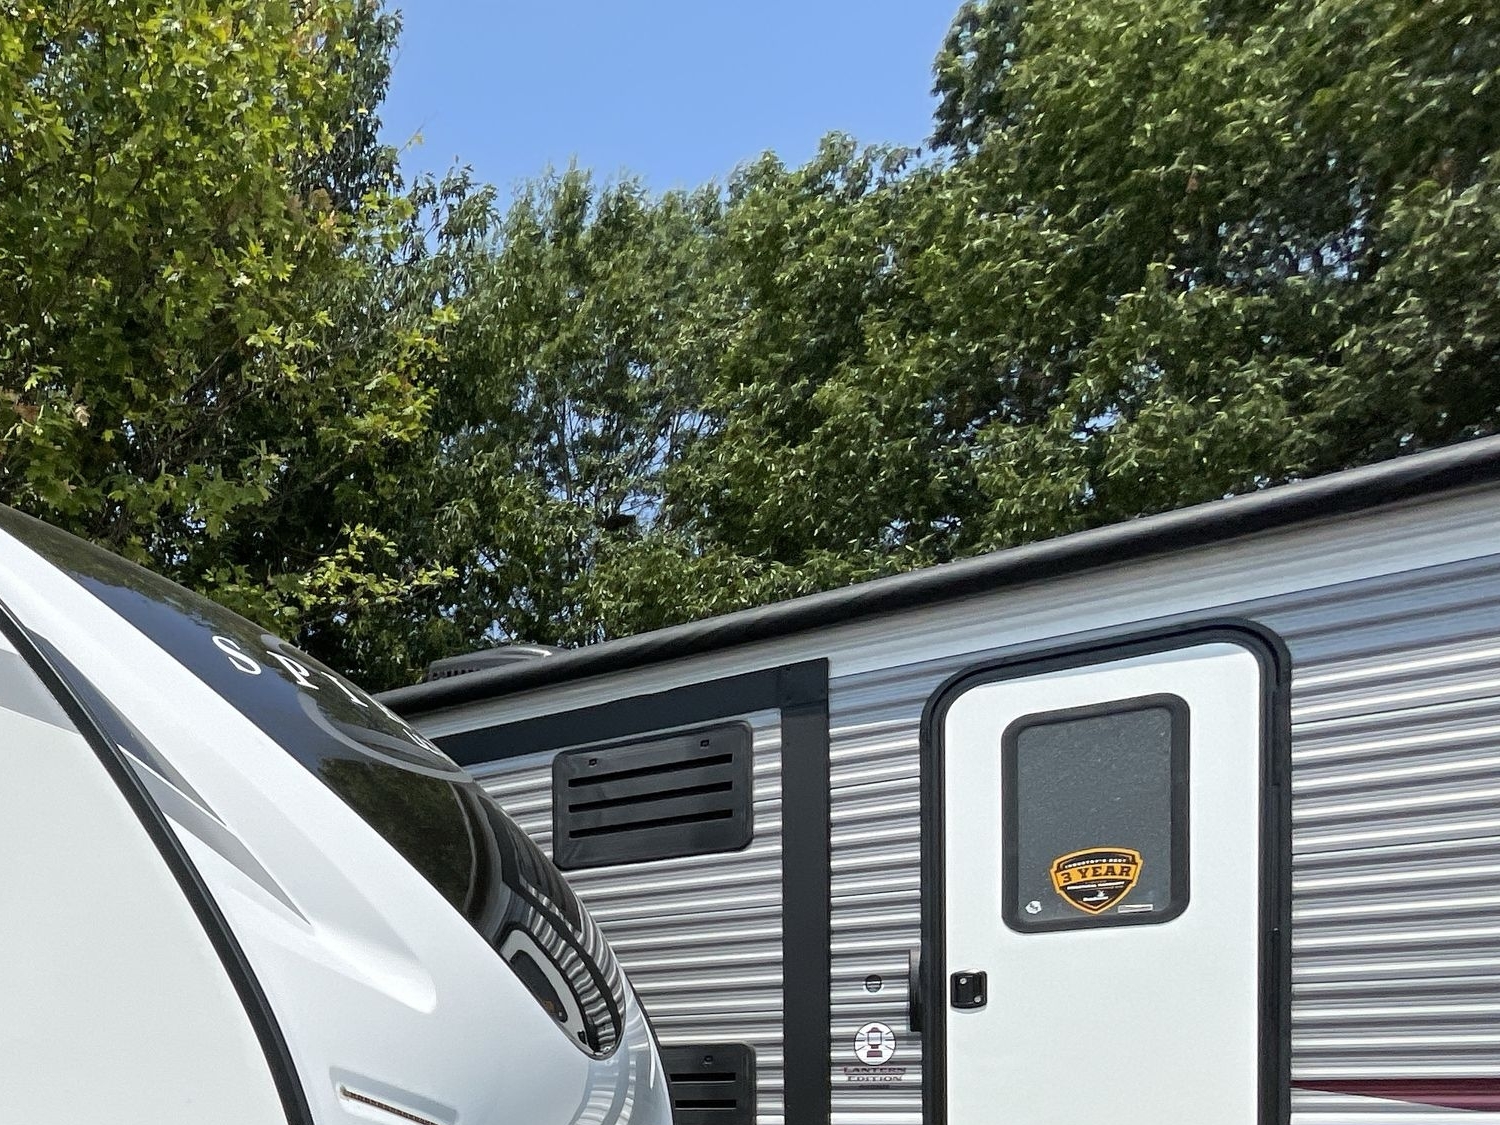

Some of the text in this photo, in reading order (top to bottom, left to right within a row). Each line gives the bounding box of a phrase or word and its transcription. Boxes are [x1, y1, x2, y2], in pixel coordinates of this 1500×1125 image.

[1061, 866, 1132, 883] 3 YEAR
[843, 1066, 907, 1074] LANTERN
